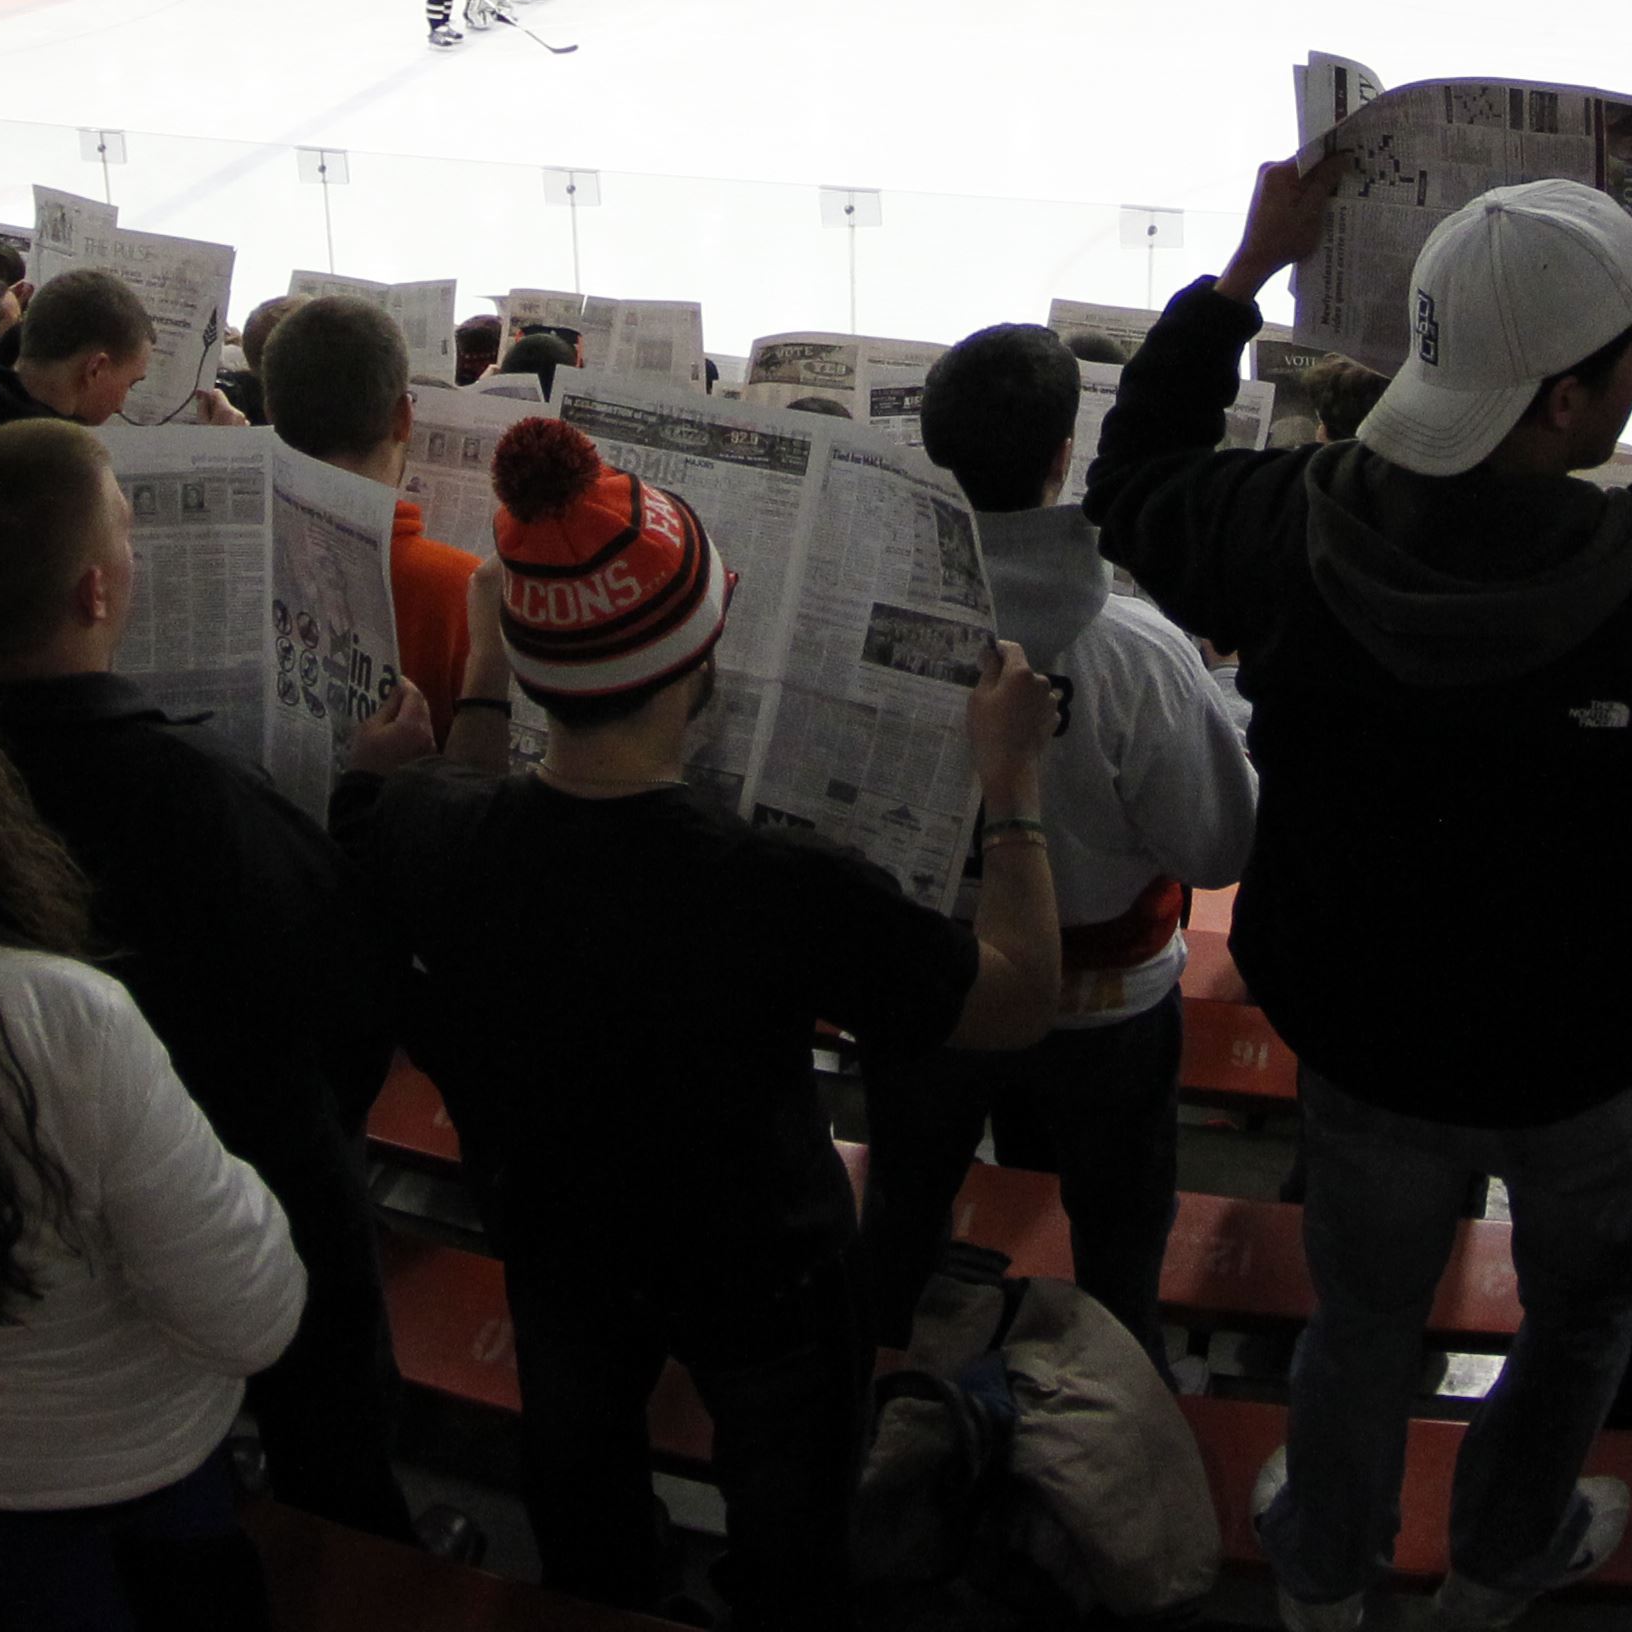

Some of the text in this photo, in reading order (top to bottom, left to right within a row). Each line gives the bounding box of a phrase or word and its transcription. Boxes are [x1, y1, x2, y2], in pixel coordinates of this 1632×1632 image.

[114, 243, 159, 262] PULSE
[778, 346, 814, 358] VOTE
[685, 457, 715, 468] MAJORS
[350, 634, 373, 696] in
